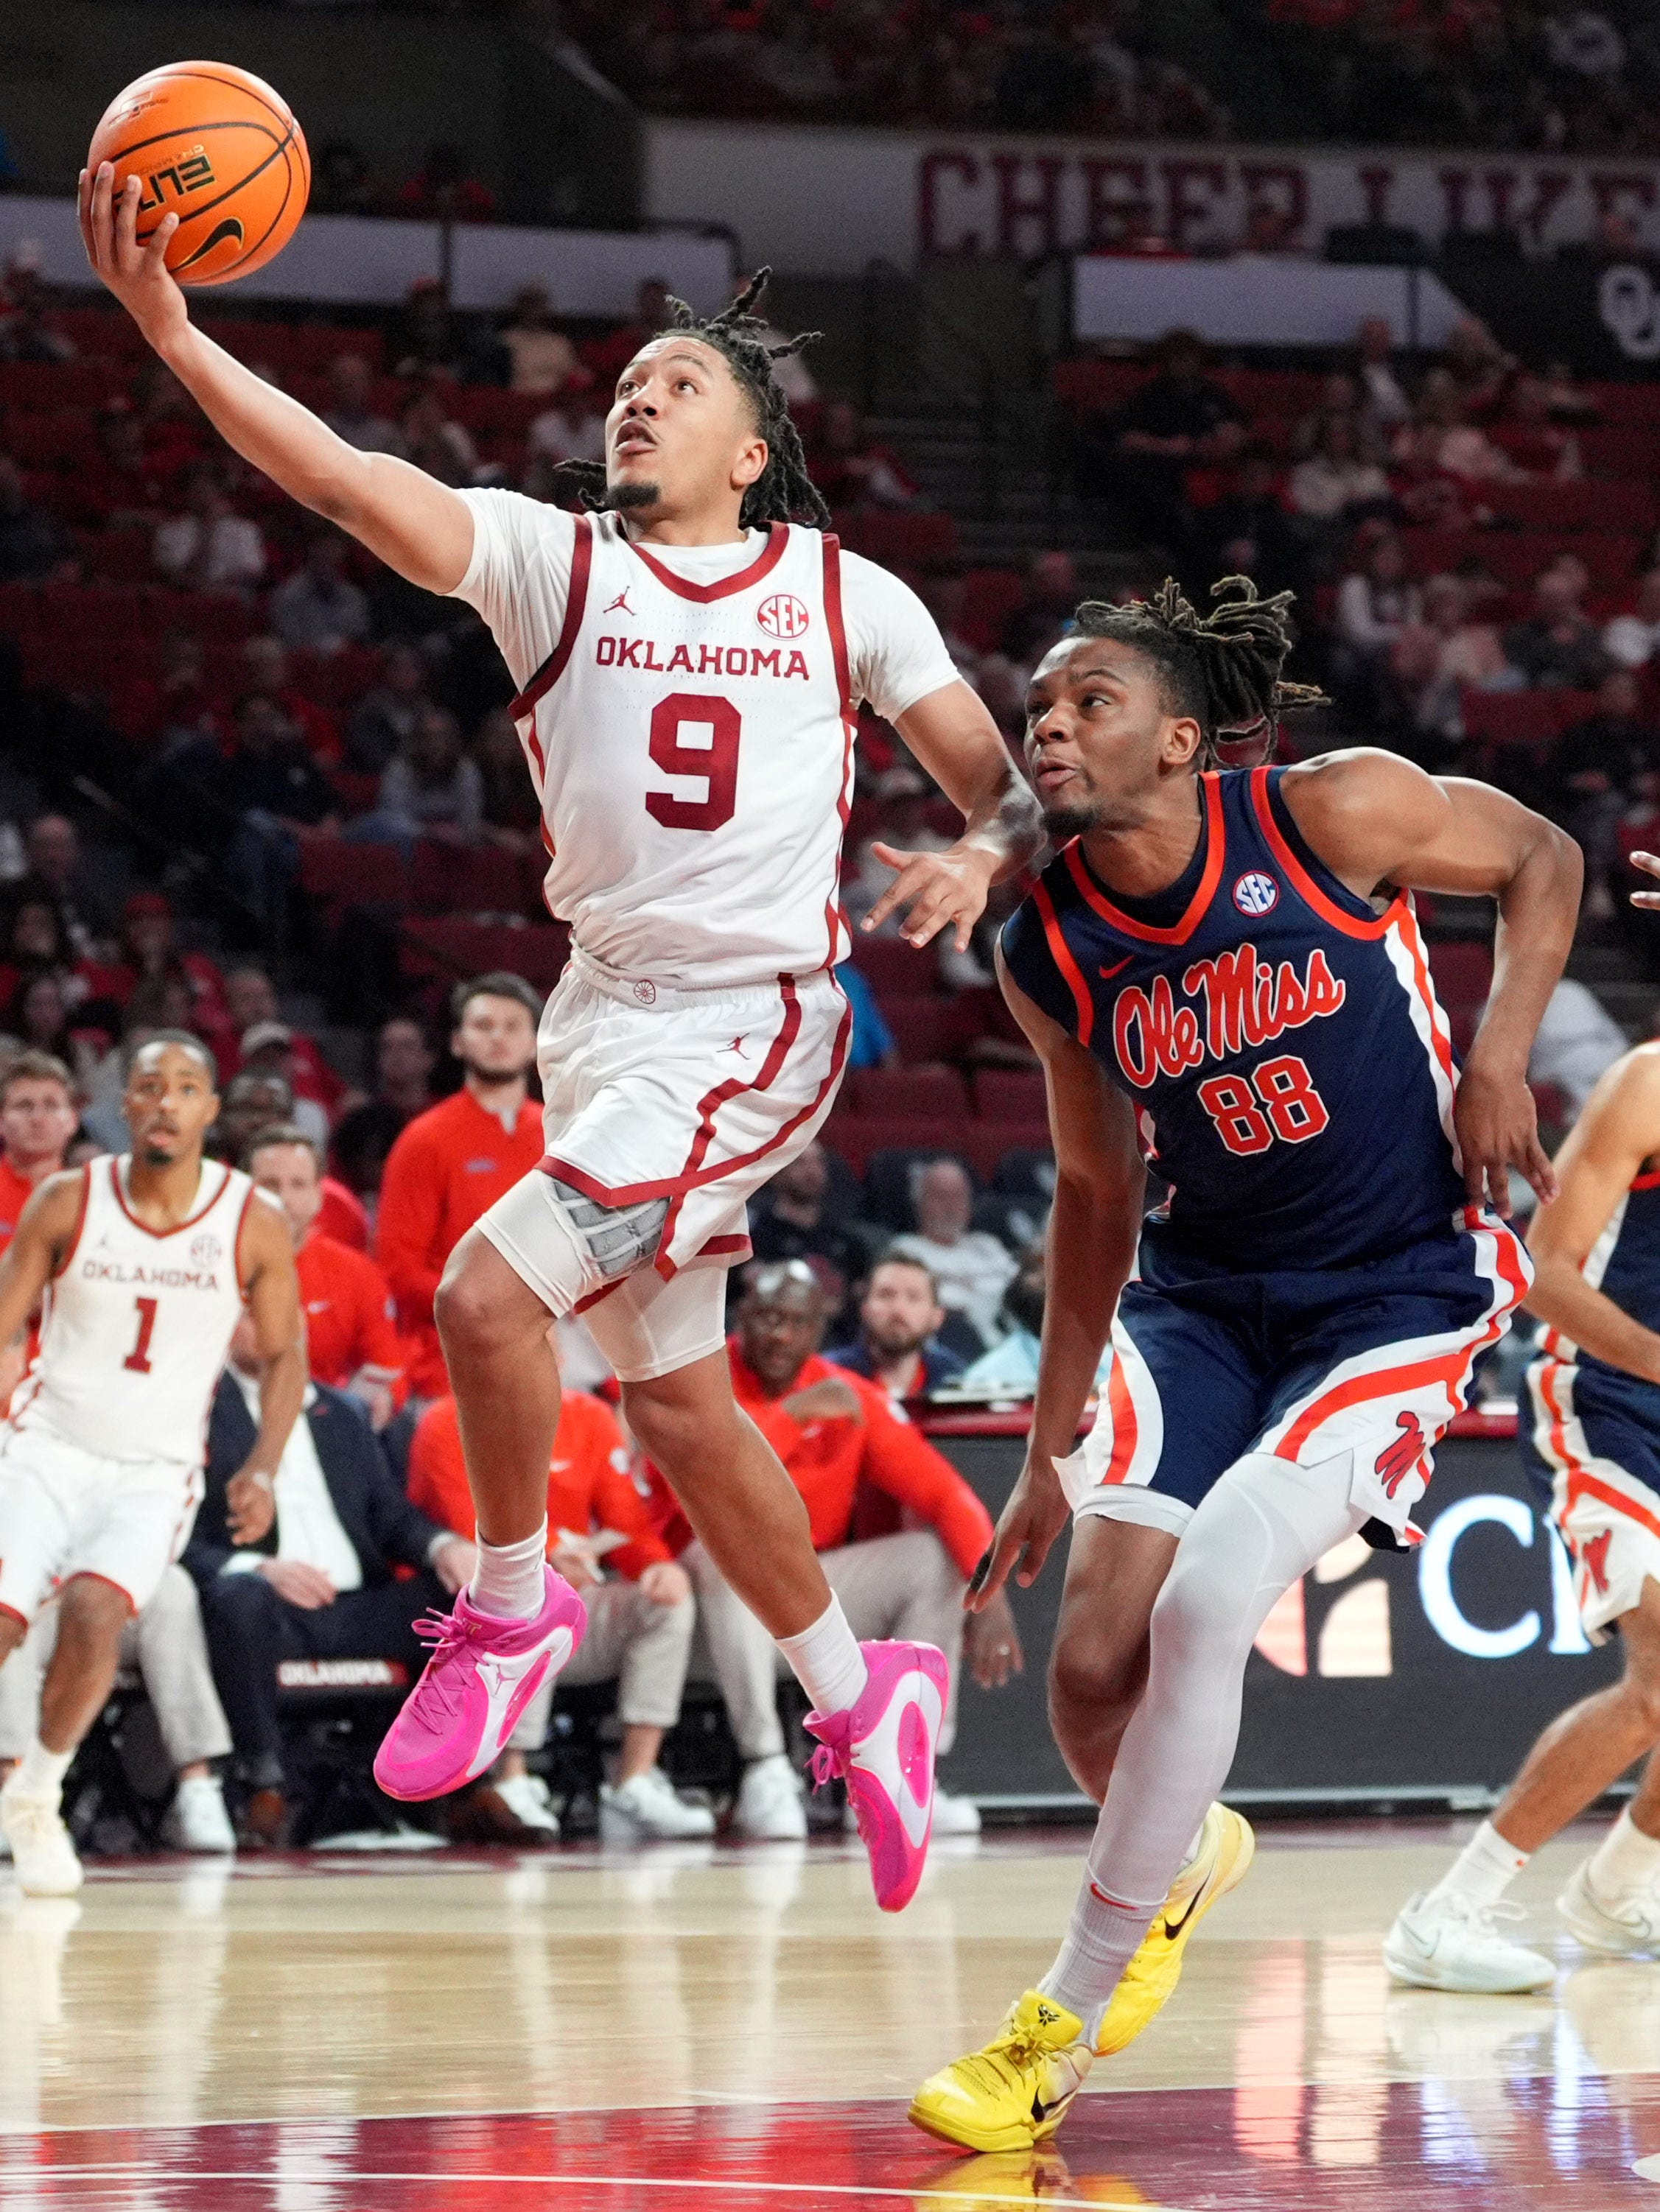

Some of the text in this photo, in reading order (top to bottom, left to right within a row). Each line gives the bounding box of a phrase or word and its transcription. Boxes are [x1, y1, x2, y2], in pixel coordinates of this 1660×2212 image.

[758, 595, 809, 638] SEC
[596, 636, 809, 681] OKLAHOMA
[645, 693, 741, 831] 9
[1235, 873, 1277, 914] SEC
[1113, 943, 1345, 1089] Ole Miss
[1197, 1054, 1330, 1156] 88
[83, 1260, 219, 1291] OKLAHOMA
[123, 1297, 158, 1374] 1
